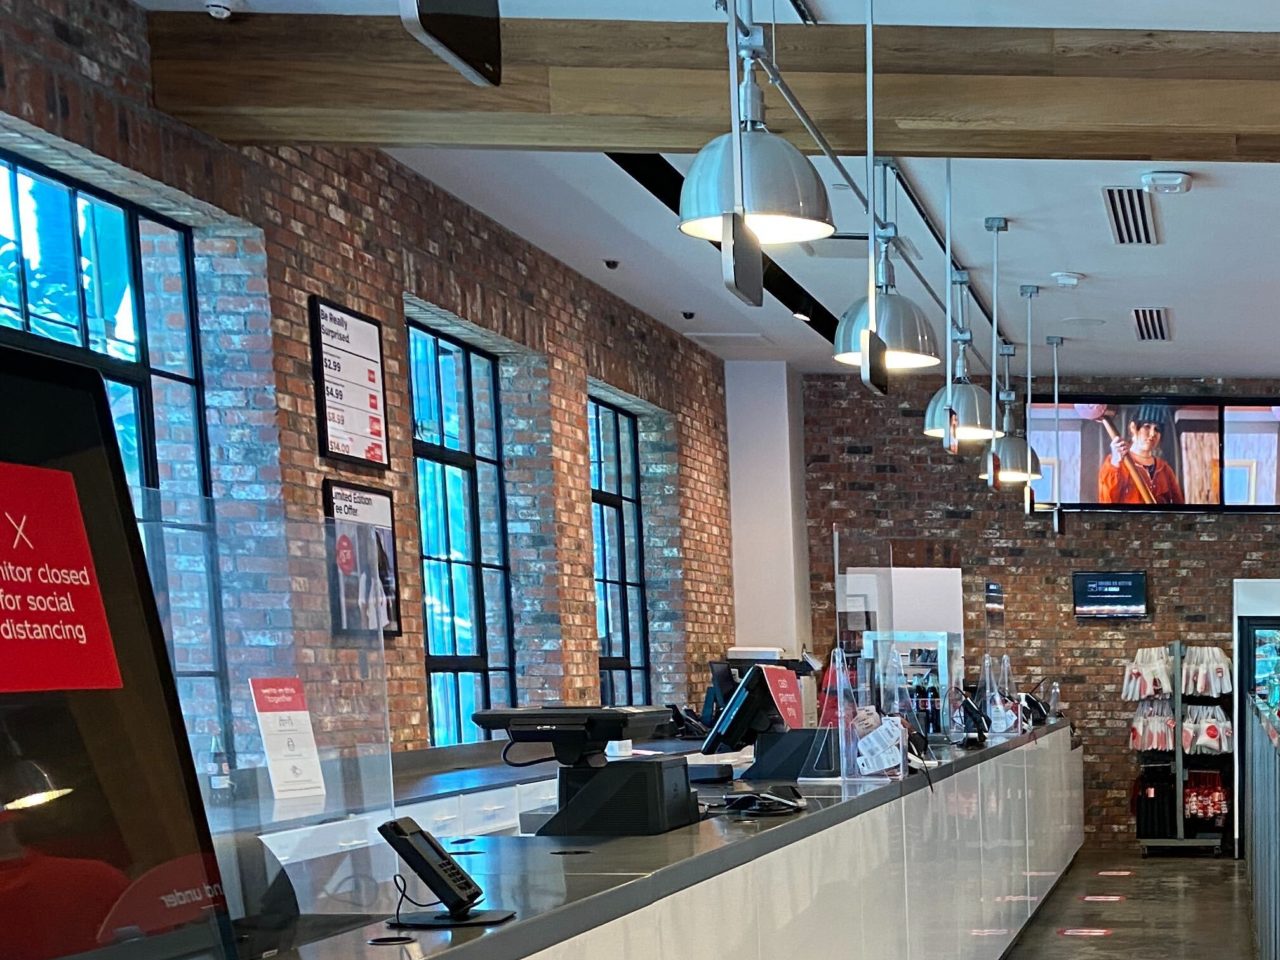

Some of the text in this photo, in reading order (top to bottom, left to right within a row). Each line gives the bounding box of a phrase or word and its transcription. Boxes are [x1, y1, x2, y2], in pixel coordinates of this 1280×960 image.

[329, 312, 348, 329] Really
[324, 357, 341, 372] $2.99
[325, 386, 343, 401] $4.99
[333, 491, 373, 506] imited Edition
[37, 563, 90, 586] closed
[0, 588, 75, 613] for social
[0, 618, 87, 645] distancing
